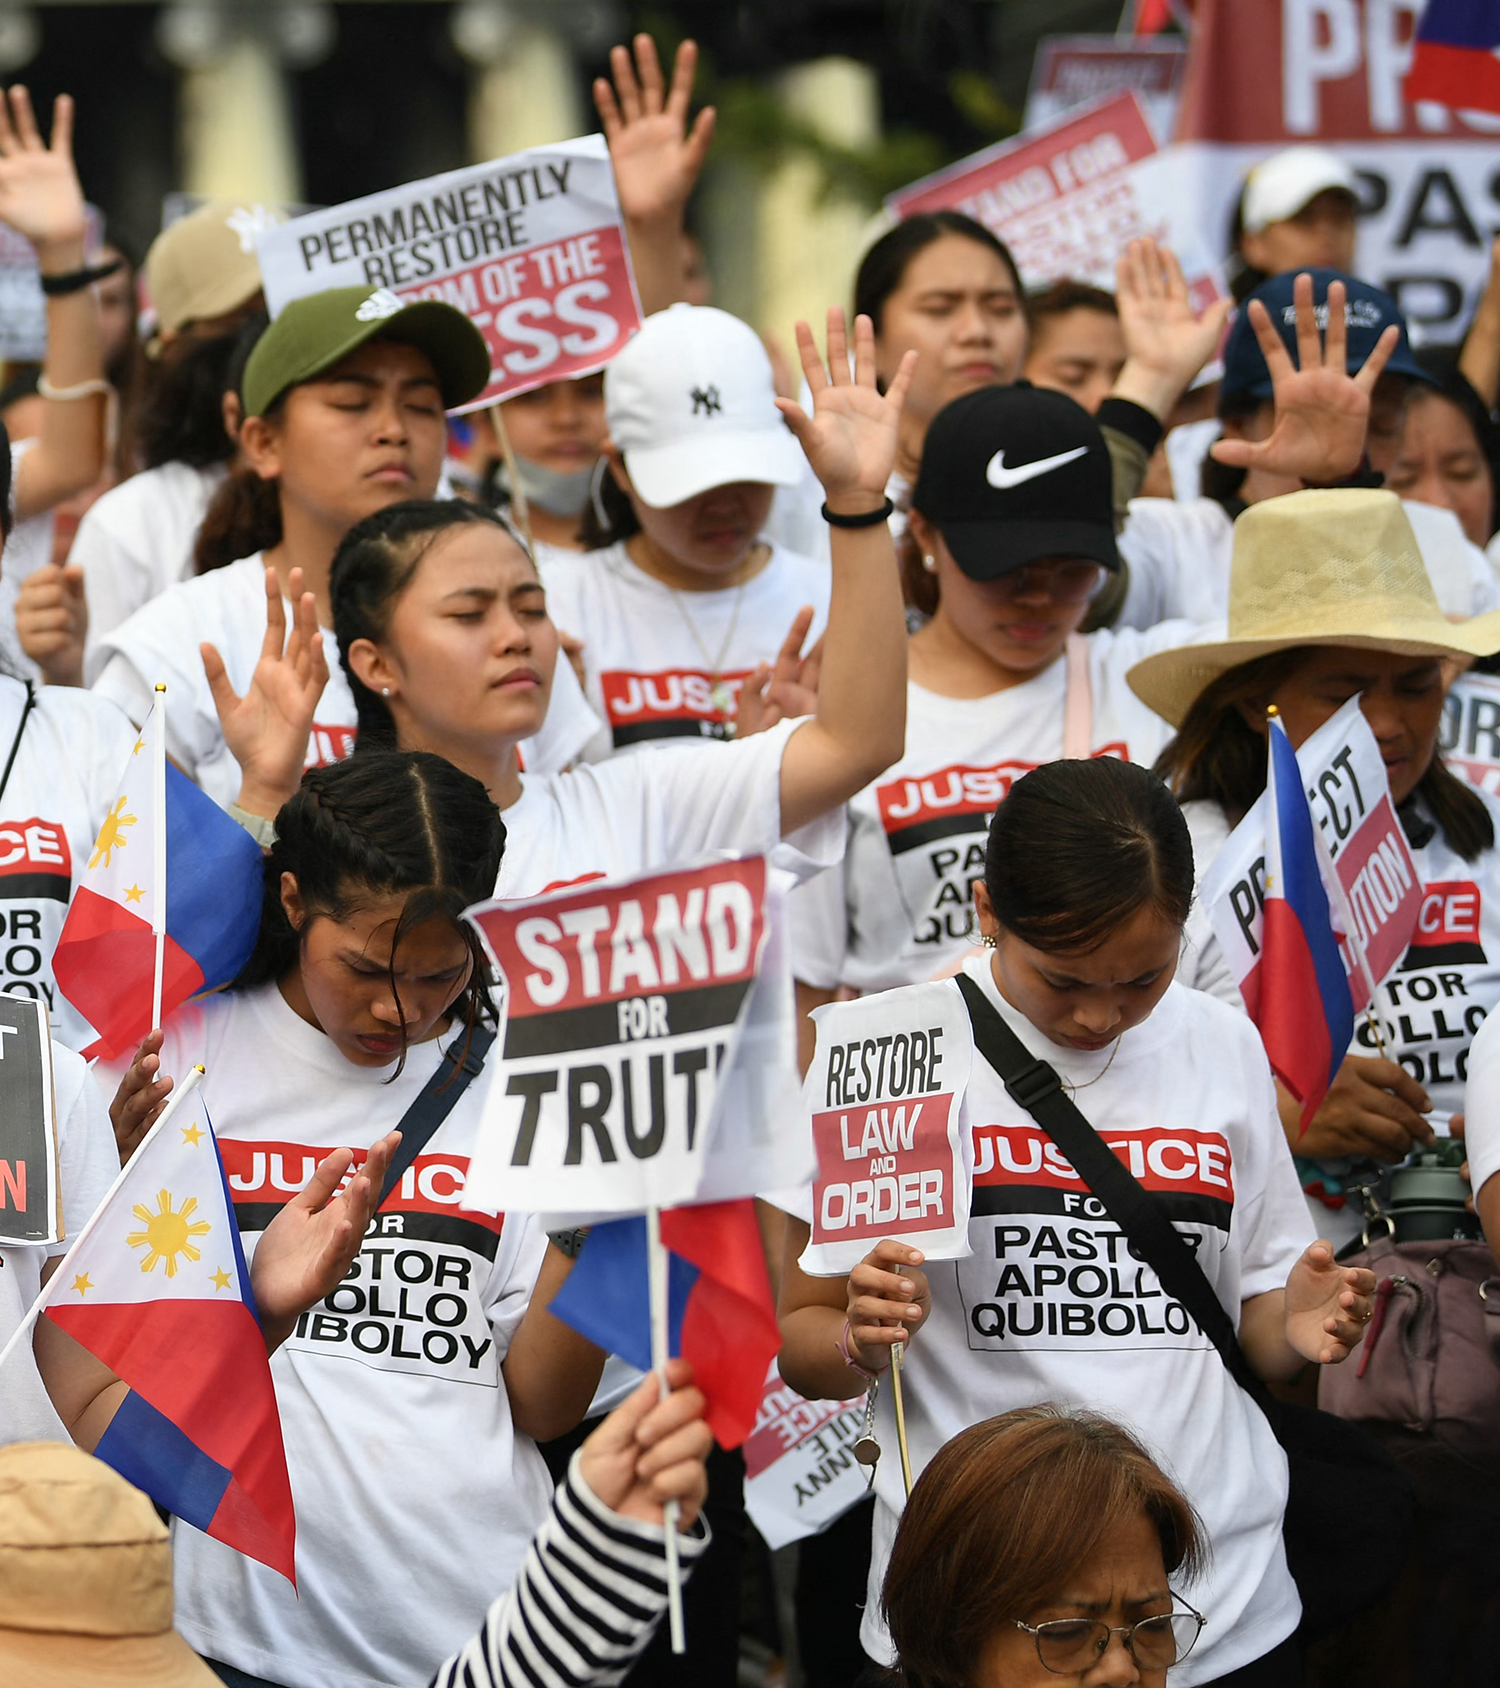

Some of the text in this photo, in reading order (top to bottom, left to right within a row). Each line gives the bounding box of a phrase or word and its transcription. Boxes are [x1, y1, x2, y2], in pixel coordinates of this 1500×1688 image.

[299, 160, 572, 272] PERMANENTLY
[363, 210, 530, 286] RESTORE
[481, 256, 526, 305] OF
[529, 234, 606, 288] THE
[515, 881, 754, 1007] STAND
[617, 995, 671, 1042] FOR
[826, 1027, 945, 1107] RESTORE
[840, 1104, 924, 1162] LAW
[972, 1136, 1229, 1188] JUSICE
[869, 1155, 896, 1177] AND
[820, 1168, 945, 1231] ORDER
[972, 1302, 1203, 1340] QUIBOLO
